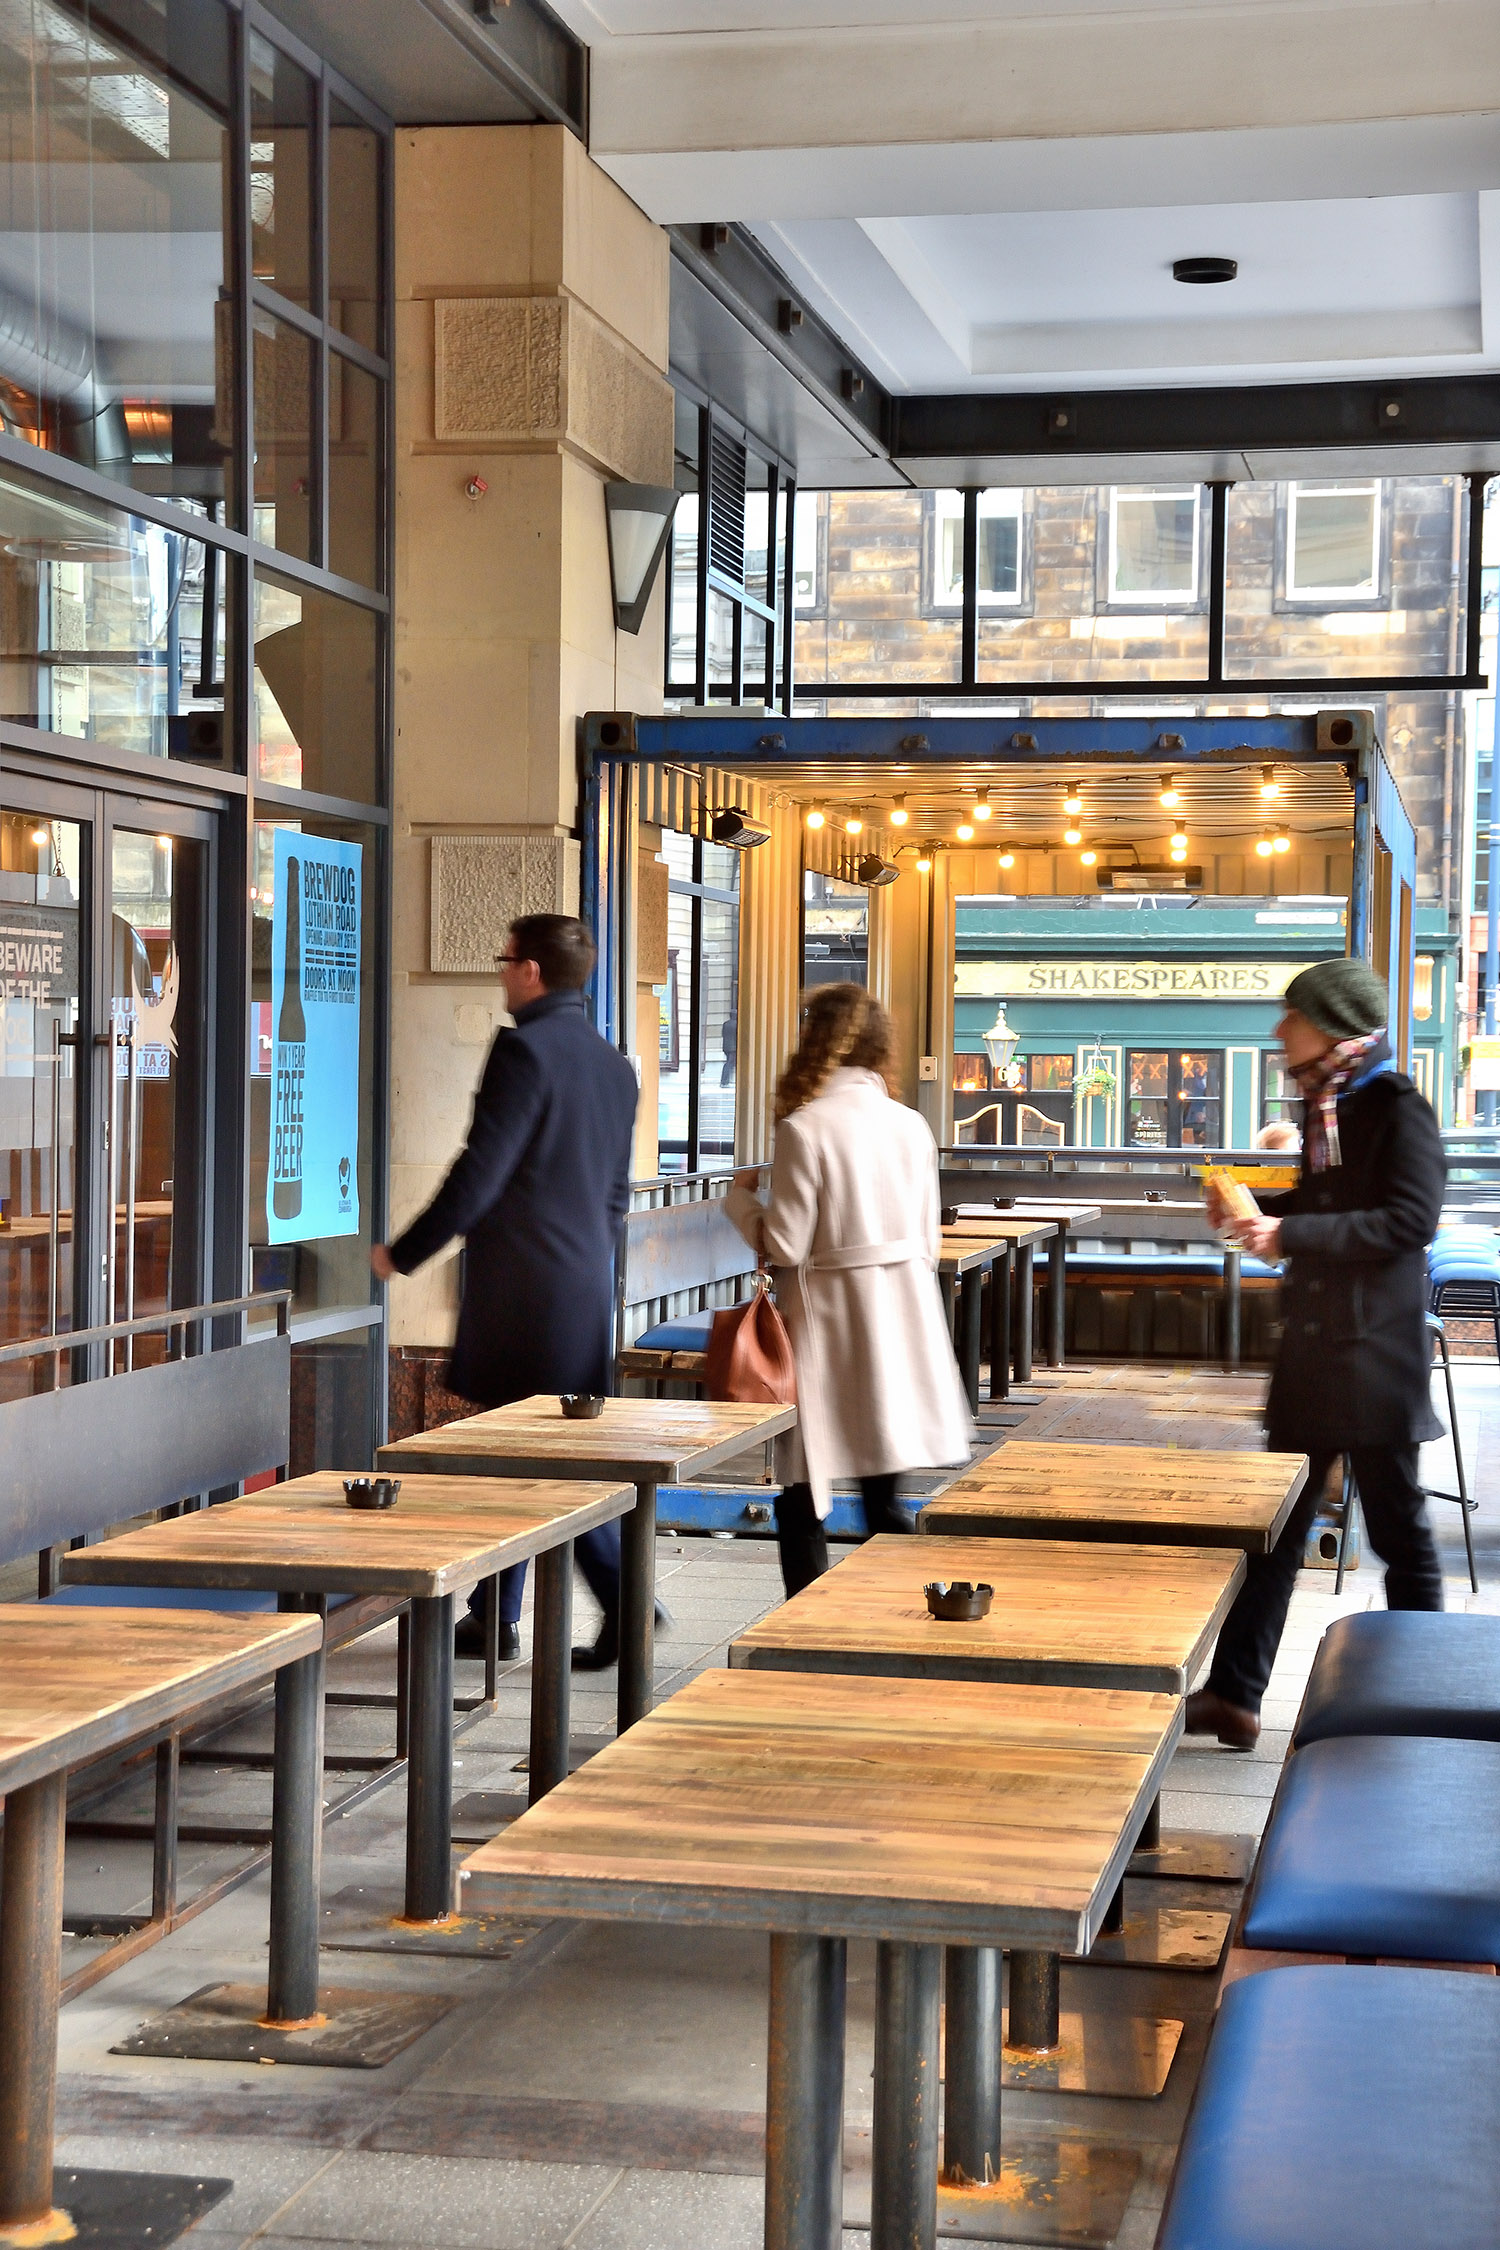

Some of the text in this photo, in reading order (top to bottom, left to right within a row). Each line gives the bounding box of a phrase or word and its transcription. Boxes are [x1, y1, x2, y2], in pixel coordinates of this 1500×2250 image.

[304, 860, 356, 905] BREWDOG
[305, 900, 357, 932] LOTHIAN ROAD
[305, 966, 357, 992] DOORS AT NOON
[1028, 967, 1269, 990] SHAKESPEARES
[18, 979, 51, 1010] THE
[292, 1045, 306, 1068] YEAR
[276, 1069, 305, 1123] FREE
[274, 1124, 304, 1179] BEER
